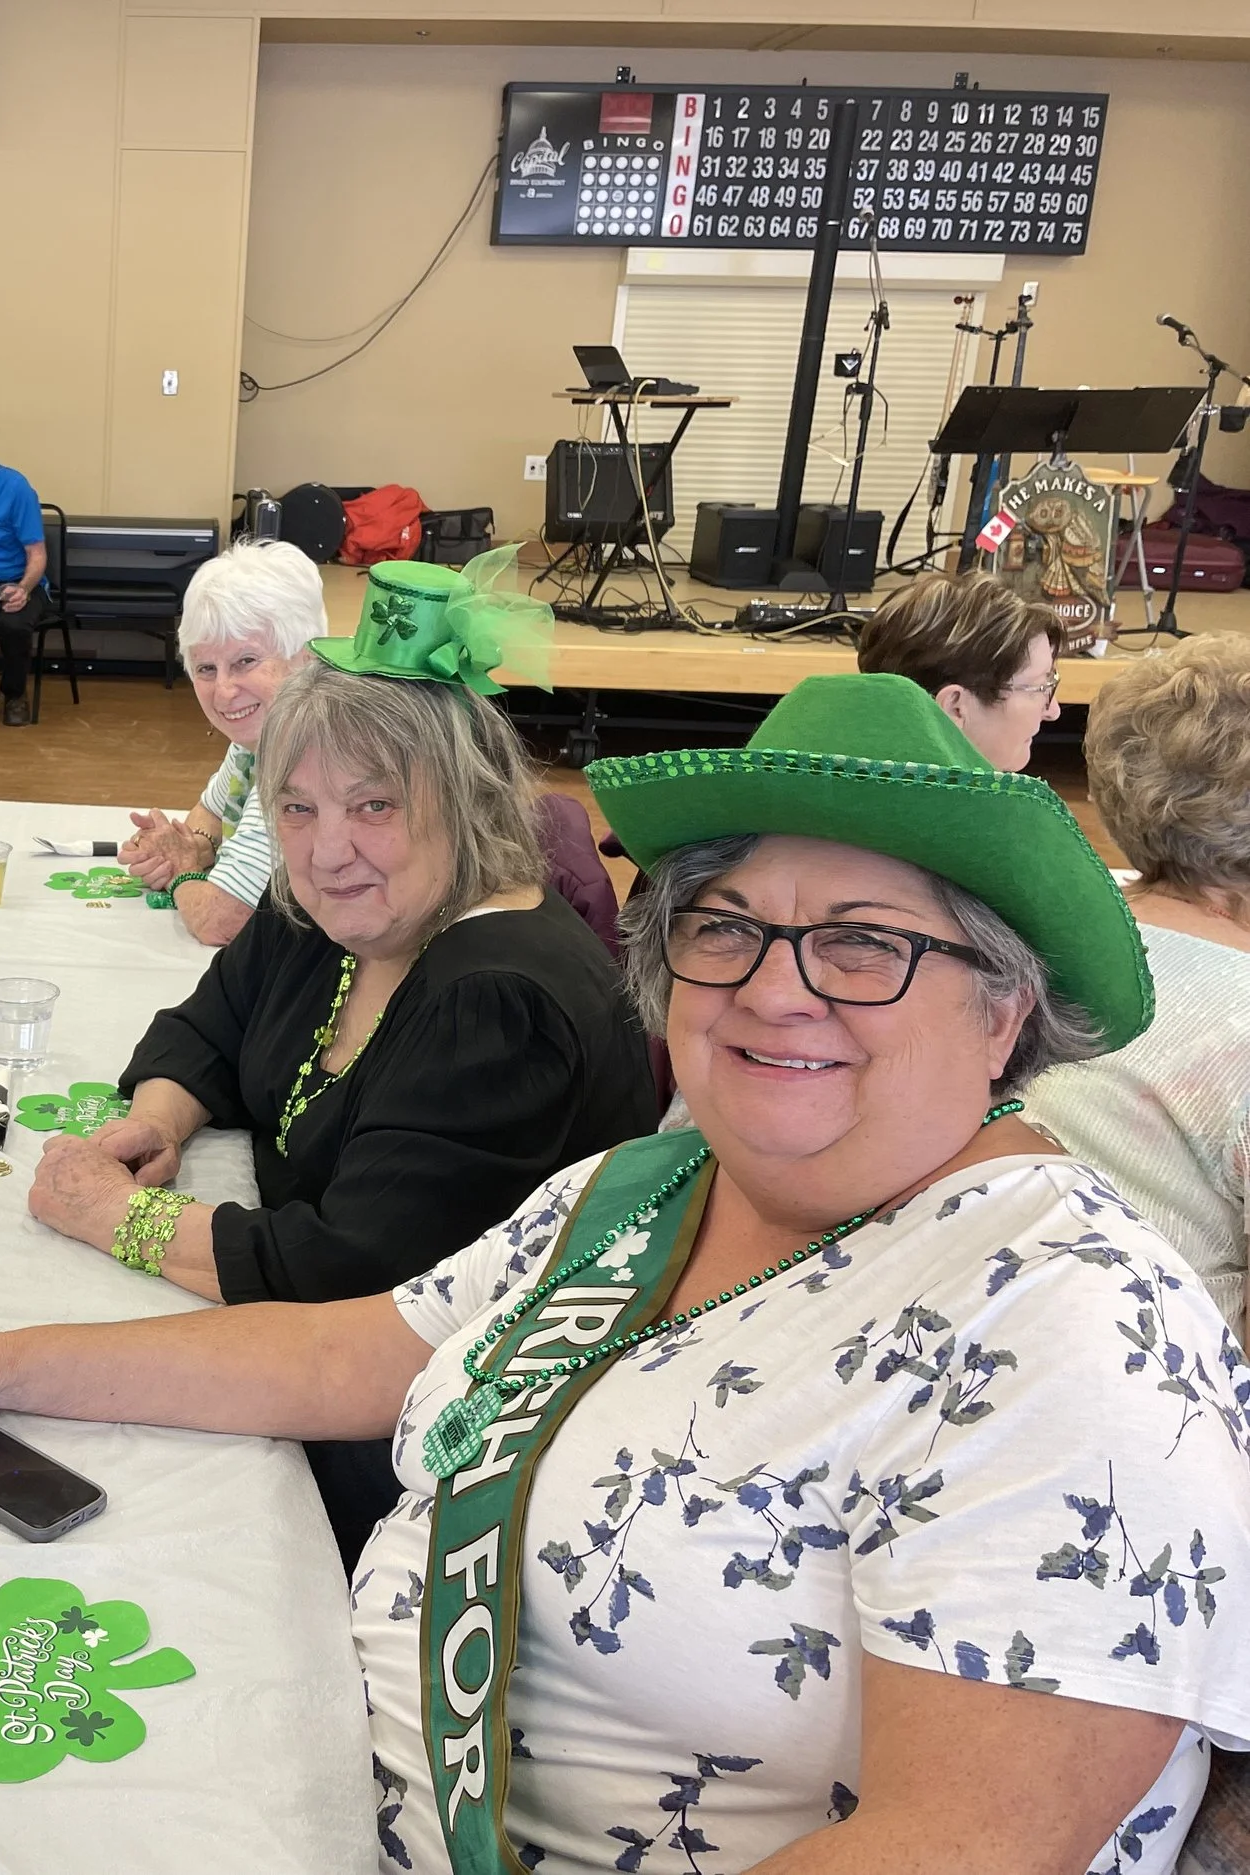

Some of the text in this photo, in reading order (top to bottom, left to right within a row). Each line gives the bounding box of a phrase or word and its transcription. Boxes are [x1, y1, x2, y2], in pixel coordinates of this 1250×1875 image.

[713, 97, 1100, 128] 1 2 3 4 5 7 8 9 10 11 12 13 14 15
[705, 125, 1098, 157] 16 17 18 19 20 22 23 24 25 26 27 28 29 30
[700, 155, 1093, 186] 31 32 33 34 35 37 38 39 40 41 42 43 44 45
[694, 184, 1088, 216] 46 47 48 49 50 52 53 54 55 56 57 58 59 60
[692, 214, 713, 237] 61
[717, 214, 740, 237] 62
[743, 215, 766, 238] 63
[769, 215, 791, 238] 64
[795, 216, 819, 238] 65
[877, 216, 900, 239] 68
[903, 217, 927, 240] 69
[931, 218, 953, 241] 70
[958, 218, 978, 241] 71
[983, 219, 1005, 242] 72
[1009, 220, 1031, 243] 73
[1036, 221, 1056, 243] 74
[1062, 222, 1083, 244] 75
[1008, 477, 1107, 513] HE MAKES A
[1053, 603, 1091, 619] HOICE
[43, 1649, 94, 1710] Day
[441, 1524, 501, 1833] FOR
